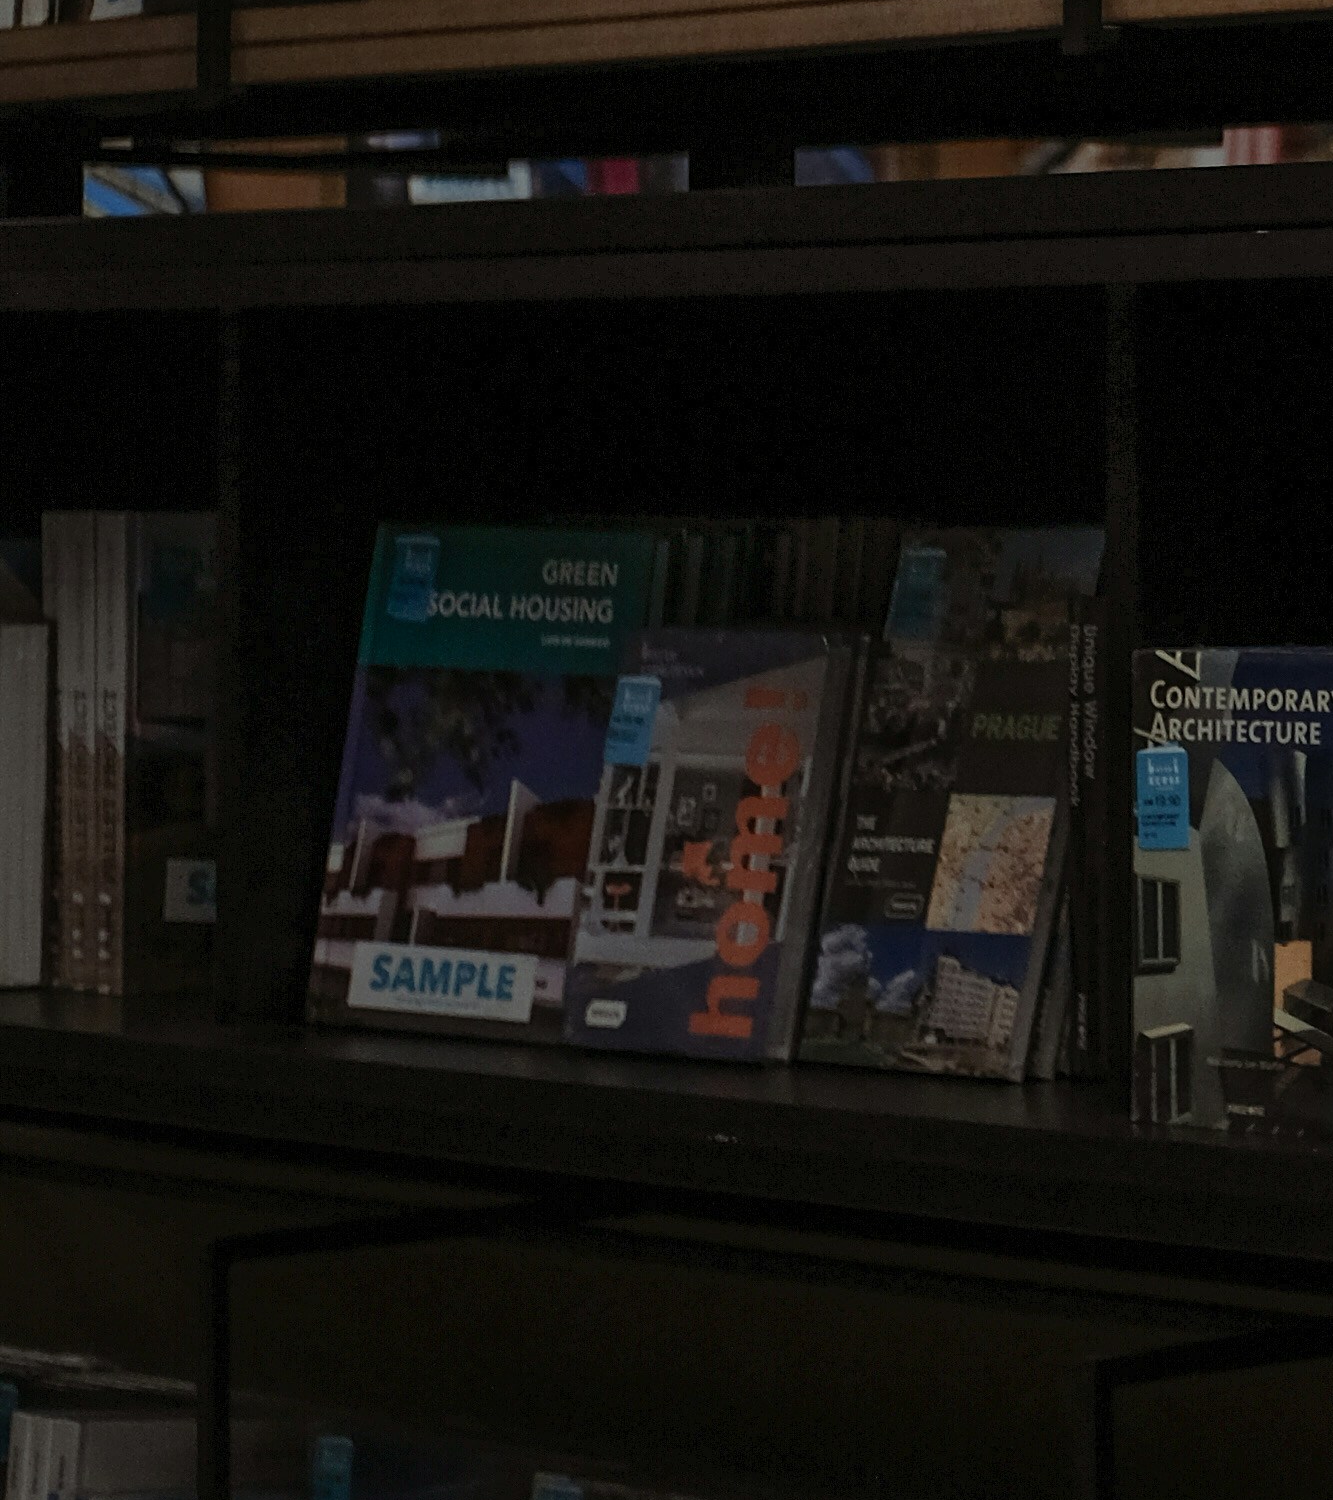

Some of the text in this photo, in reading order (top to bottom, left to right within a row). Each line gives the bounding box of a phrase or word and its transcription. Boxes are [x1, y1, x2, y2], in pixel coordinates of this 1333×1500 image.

[542, 558, 619, 588] GREEN
[428, 590, 614, 624] SOCIAL HOUSING
[971, 713, 1063, 741] PRAGUE
[1084, 700, 1098, 779] Window
[1149, 711, 1321, 745] ARCHITECTURE
[368, 954, 516, 1001] SAMPLE
